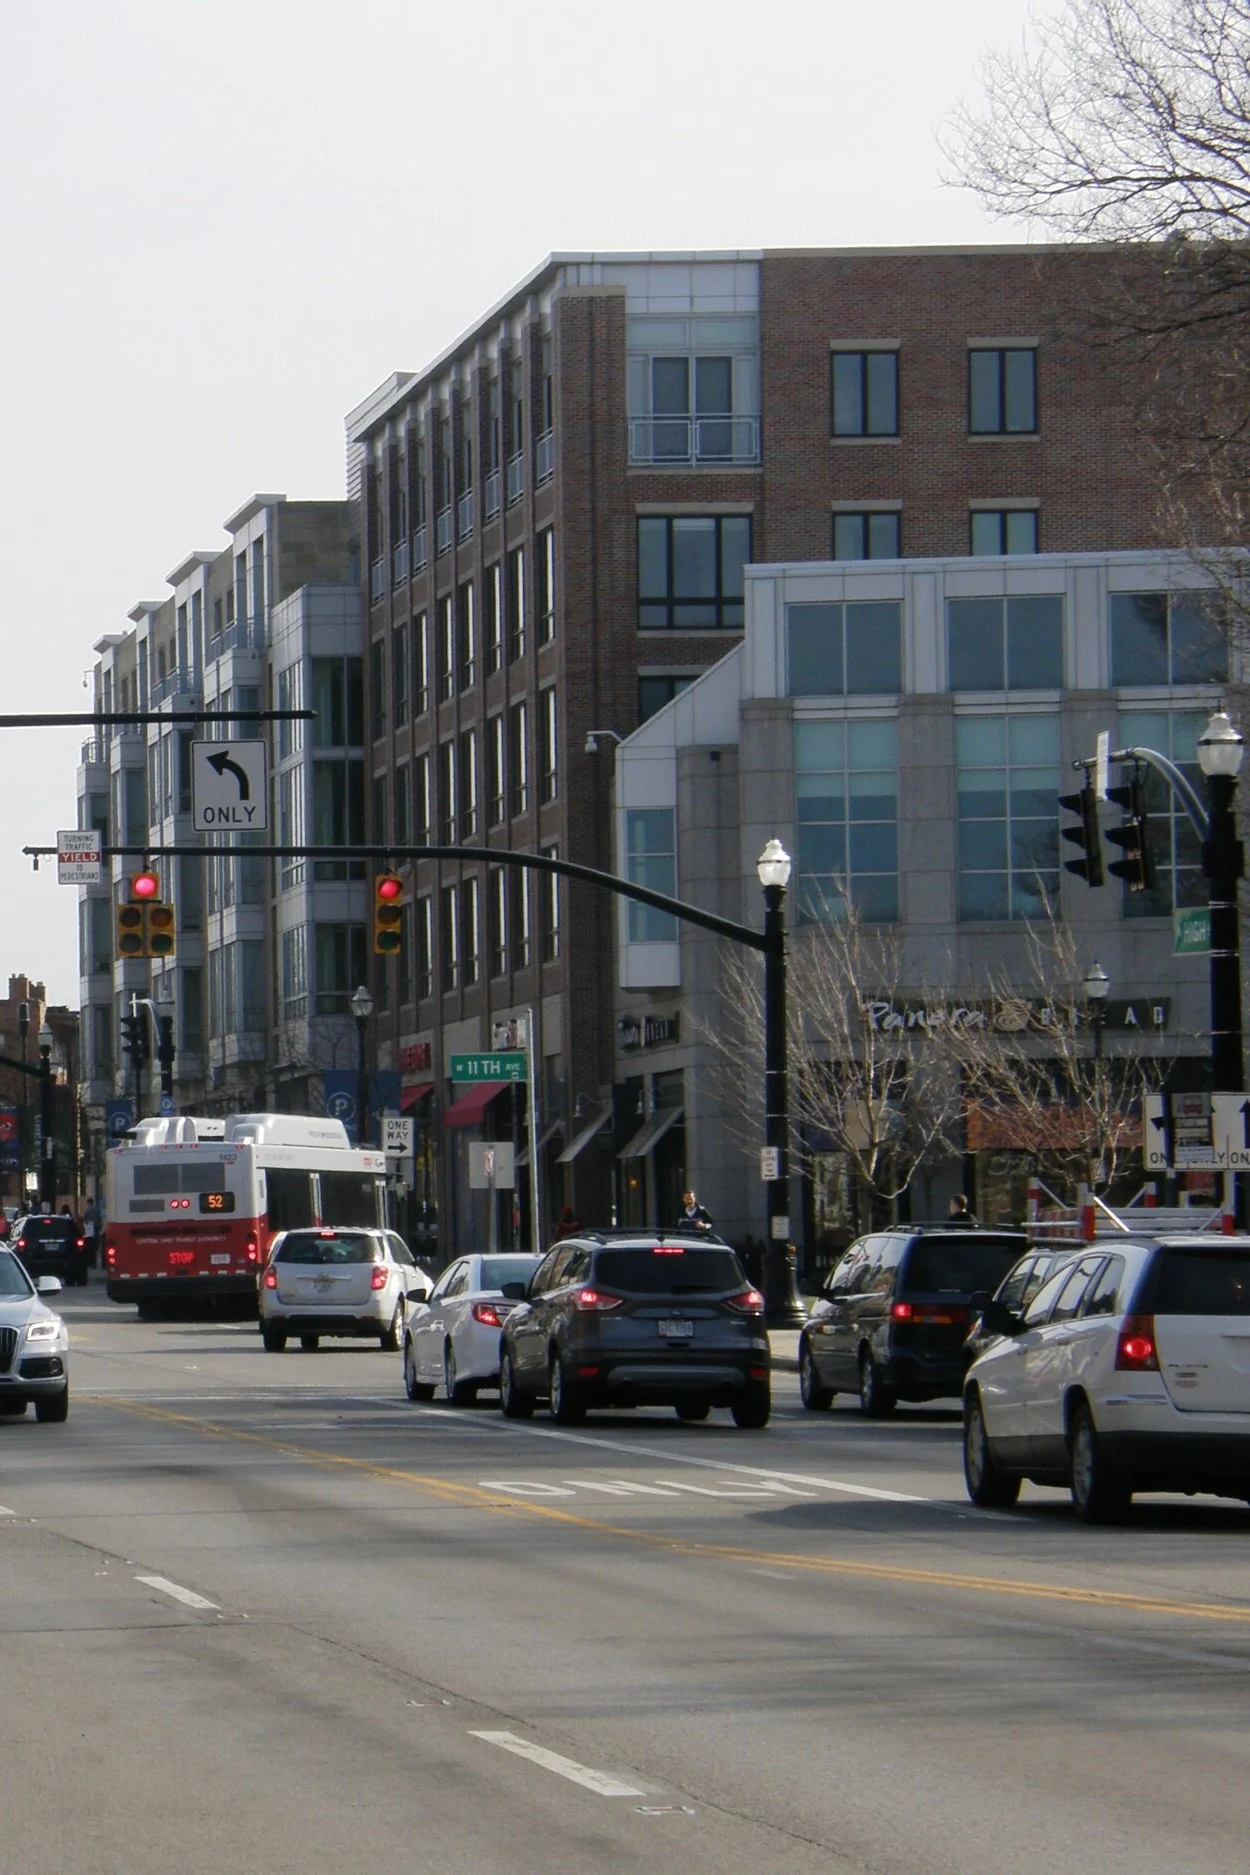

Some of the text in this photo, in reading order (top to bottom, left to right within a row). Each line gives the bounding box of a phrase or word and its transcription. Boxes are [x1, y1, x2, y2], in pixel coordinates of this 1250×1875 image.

[204, 806, 256, 823] ONLY
[61, 853, 97, 862] YIELD
[61, 872, 98, 880] PEDESTRIANS
[864, 1001, 988, 1031] Panera
[467, 1061, 501, 1075] 11TH
[505, 1063, 521, 1071] AVE
[387, 1121, 408, 1130] ONE
[387, 1131, 408, 1140] WAY
[208, 1195, 223, 1208] 52
[170, 1252, 194, 1264] STOP
[477, 1480, 820, 1497] ONLY
